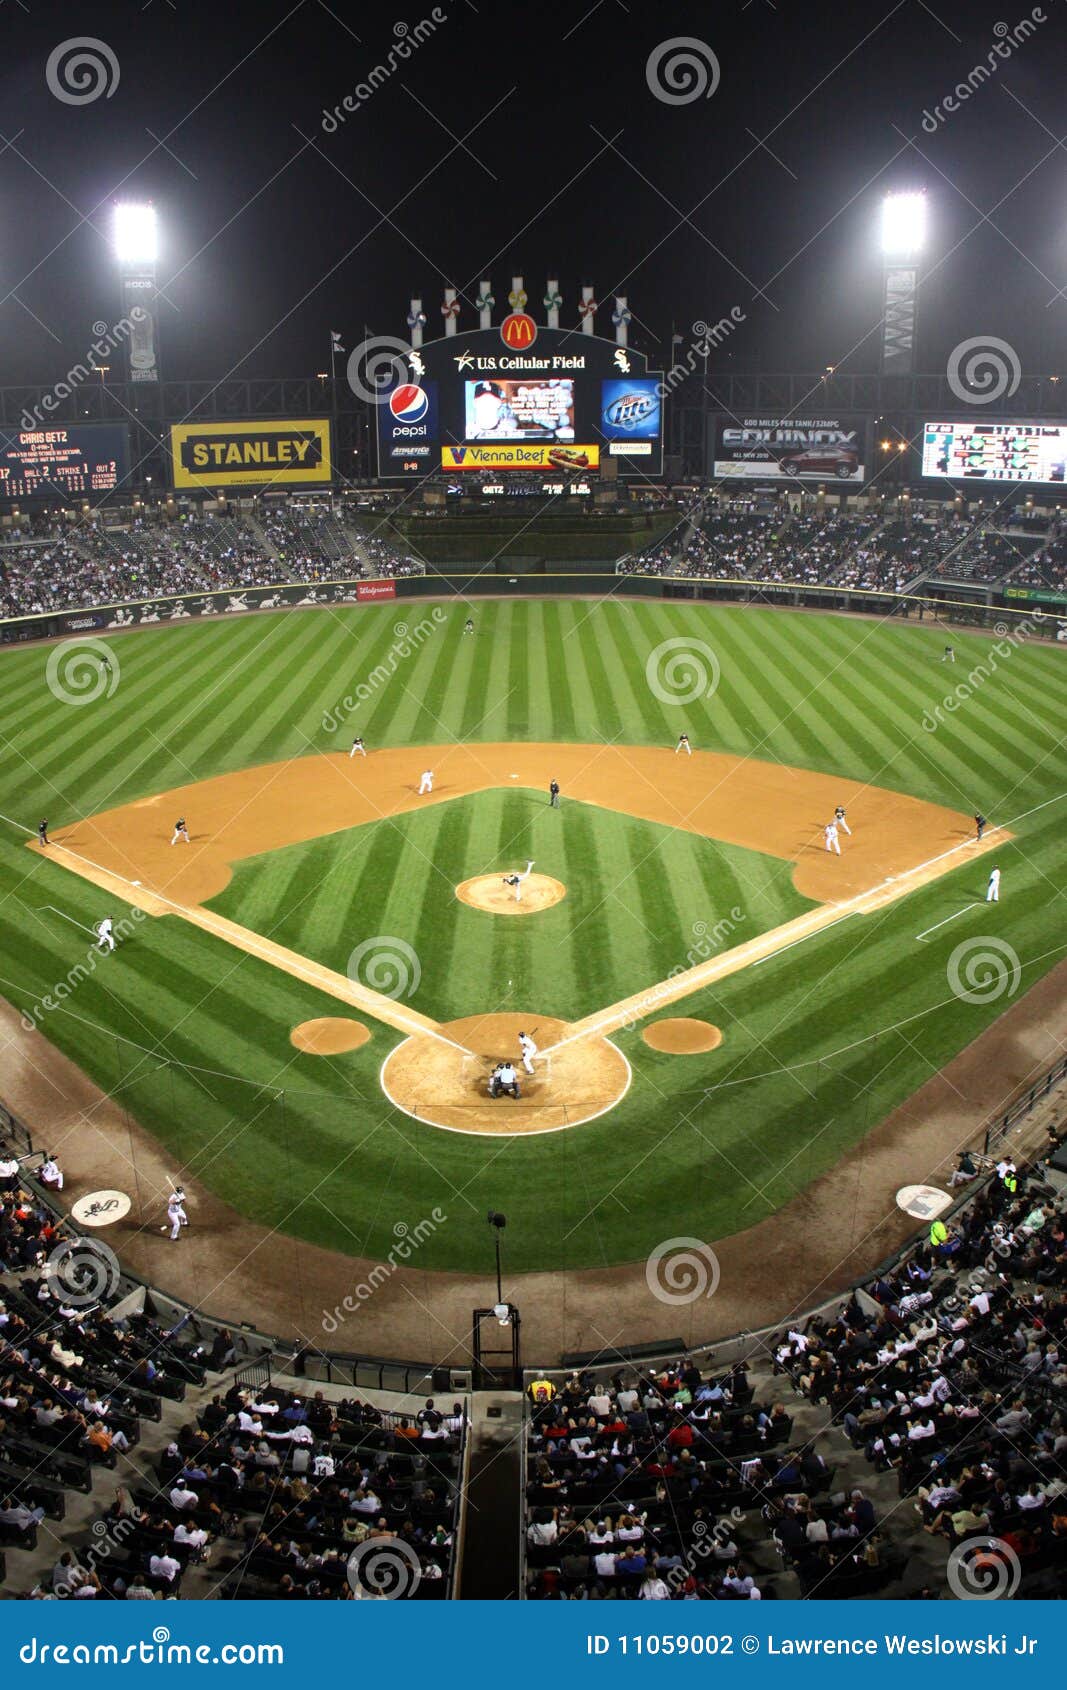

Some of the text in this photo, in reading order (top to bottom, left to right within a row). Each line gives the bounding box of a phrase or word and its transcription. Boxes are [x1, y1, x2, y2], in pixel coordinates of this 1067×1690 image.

[477, 356, 586, 370] U.S. Cellular Field
[759, 419, 778, 427] MILES
[20, 431, 68, 444] CHRIS GETZ
[393, 425, 427, 438] pepsi
[723, 428, 857, 449] EQUINOX
[193, 440, 311, 466] STANLEY
[470, 449, 514, 461] Vienna
[516, 448, 545, 464] Beef
[24, 469, 40, 478] BALL
[43, 466, 50, 476] 2
[56, 466, 80, 475] STRIKE
[83, 463, 88, 474] 1
[96, 464, 108, 473] OUT
[110, 461, 116, 472] 2
[482, 485, 504, 494] GETZ
